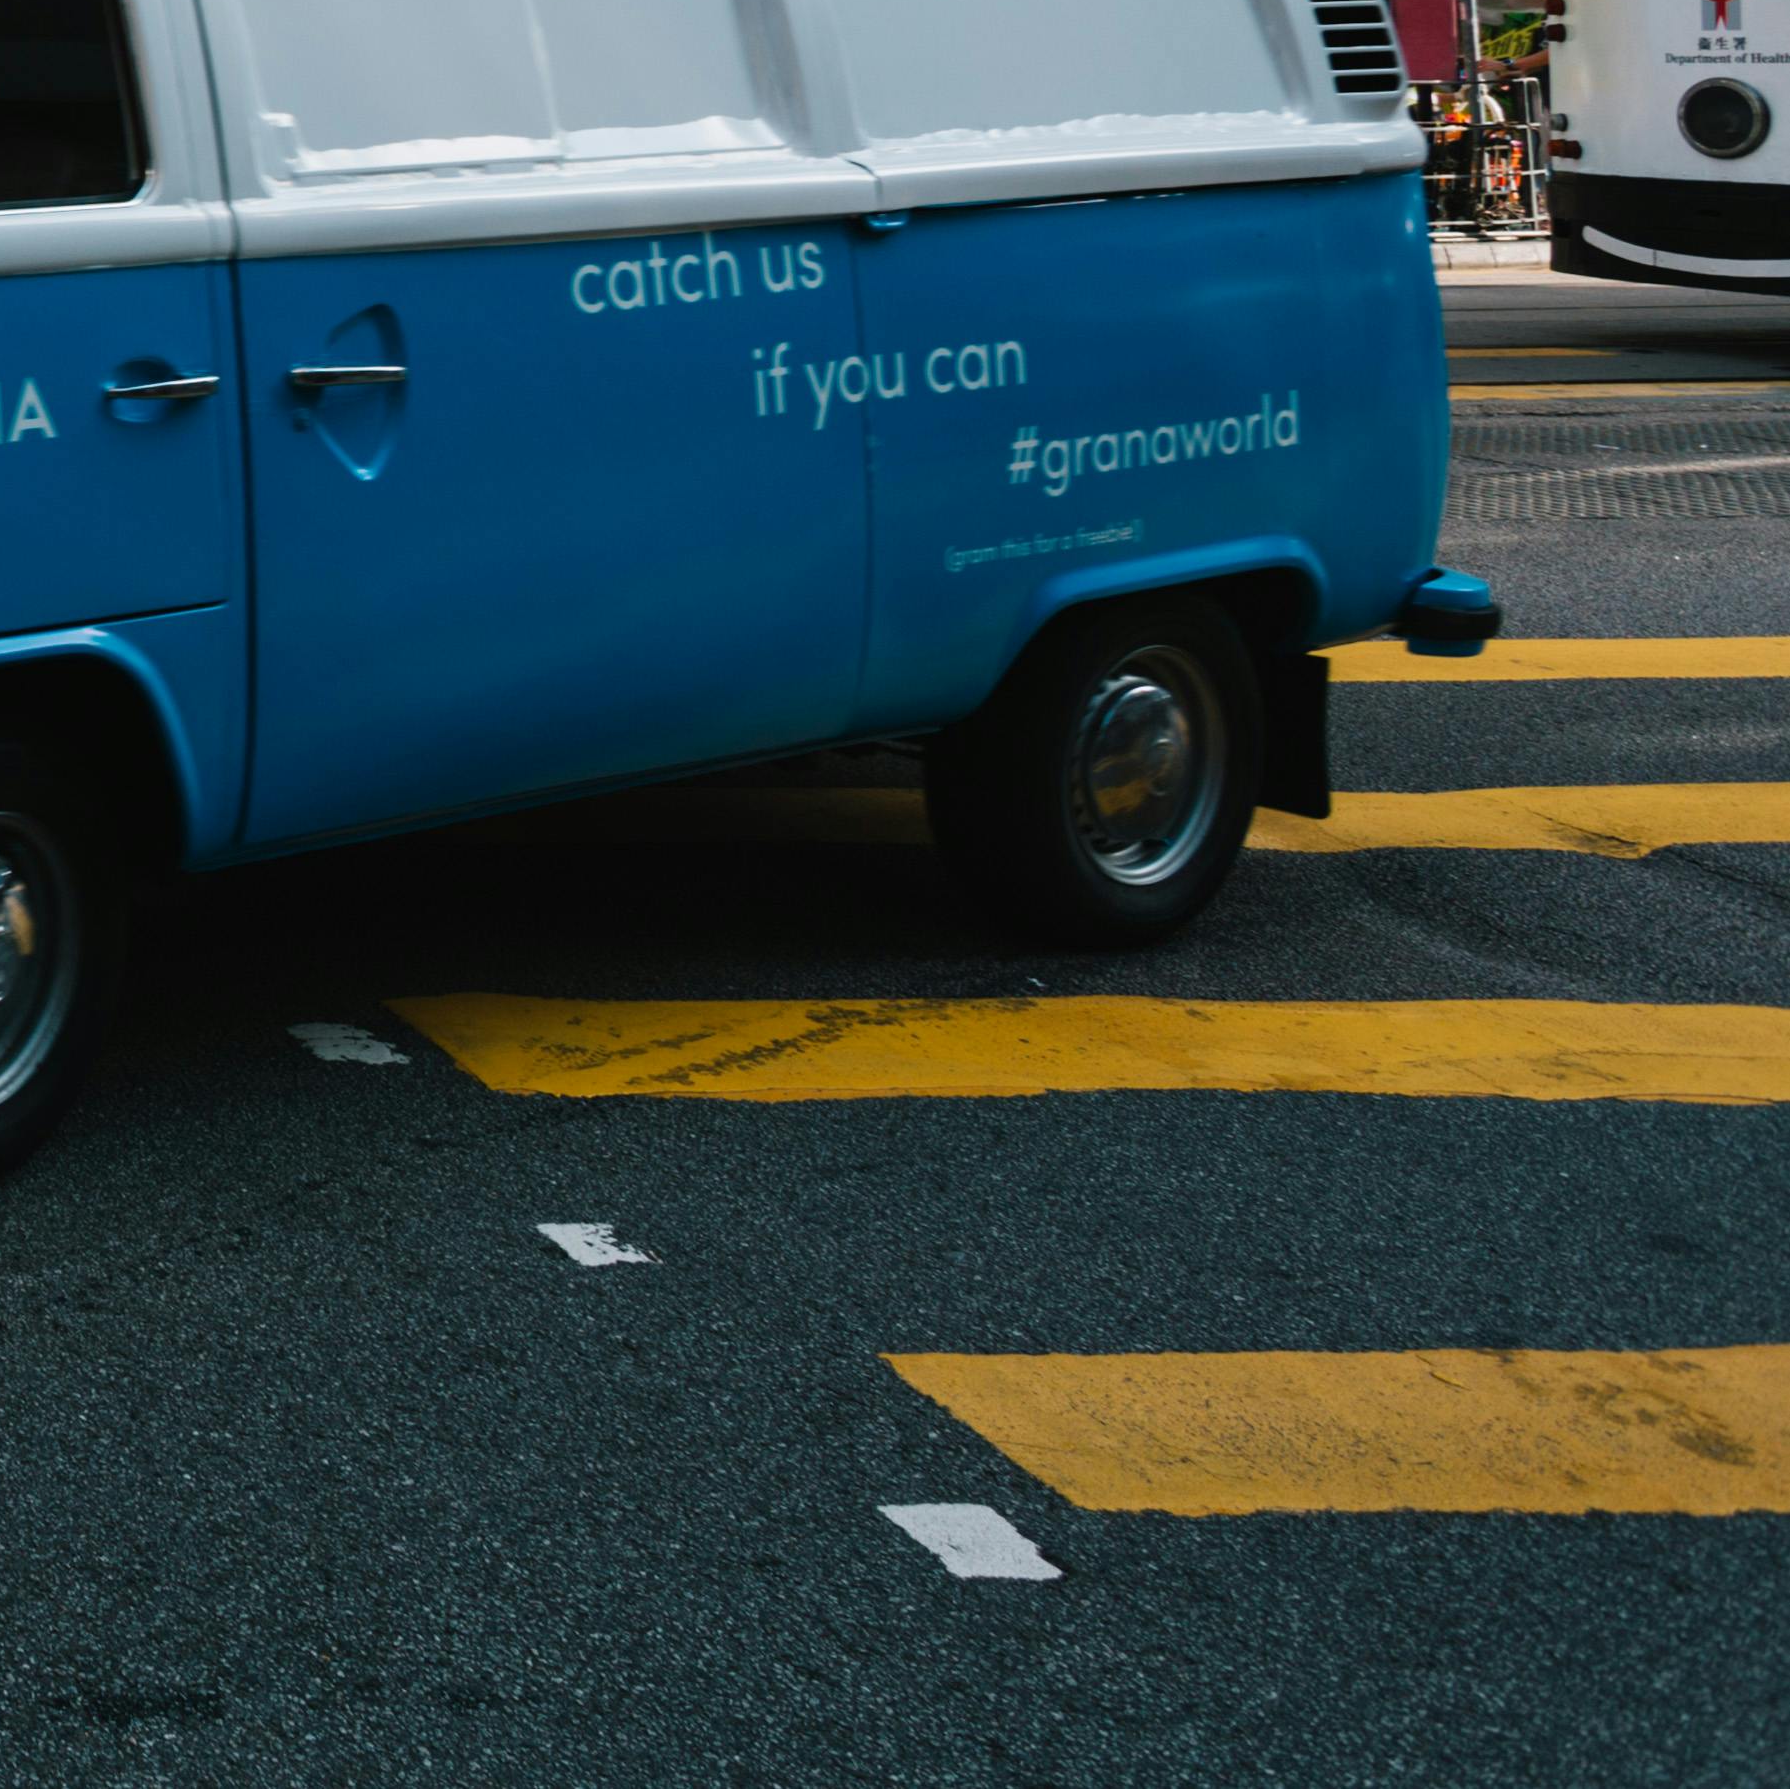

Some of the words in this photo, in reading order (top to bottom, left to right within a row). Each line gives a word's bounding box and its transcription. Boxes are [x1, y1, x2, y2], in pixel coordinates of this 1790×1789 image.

[1665, 53, 1731, 65] Department
[1734, 53, 1747, 63] of
[1750, 53, 1790, 63] Health
[571, 230, 742, 314] catch
[760, 240, 824, 294] us
[753, 342, 791, 416] if
[806, 352, 907, 430] you
[927, 339, 1028, 394] can
[1008, 390, 1300, 497] #granaworld
